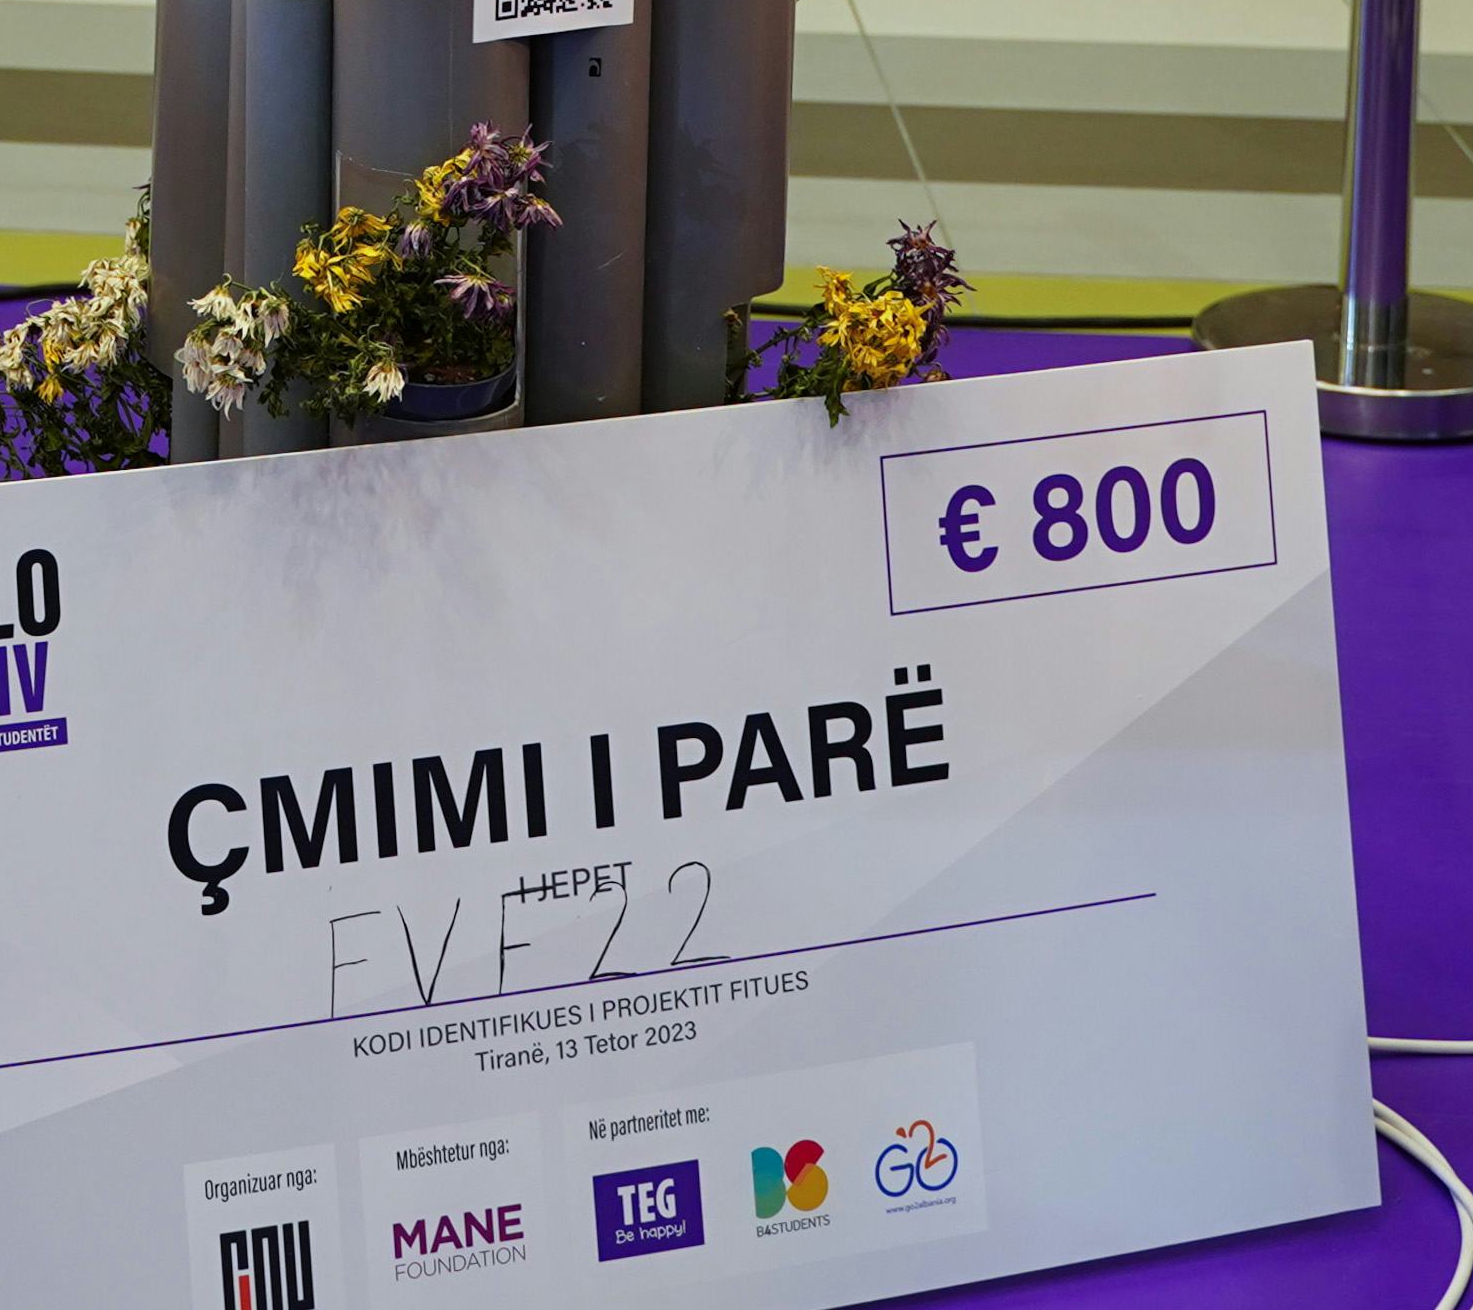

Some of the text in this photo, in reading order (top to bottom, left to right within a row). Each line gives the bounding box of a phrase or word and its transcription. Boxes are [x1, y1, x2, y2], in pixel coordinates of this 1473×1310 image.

[938, 457, 1216, 573] € 800
[166, 664, 951, 915] ÇMIMI I PARË
[537, 861, 633, 902] JEPET
[352, 970, 810, 1059] KODI IDENTIFIKUES I PROJEKTIT FITUES
[475, 1020, 698, 1072] Tiranë, 13 Tetor 2023
[589, 1106, 711, 1141] Në partneritet me:
[396, 1137, 510, 1171] Mbështetur nga:
[204, 1167, 318, 1202] Organizuar nga:
[617, 1177, 677, 1226] TEG
[392, 1203, 525, 1259] MANE
[615, 1219, 686, 1245] Be happy!
[756, 1214, 831, 1238] B4STUDENTS
[395, 1244, 527, 1281] FOUNDATION
